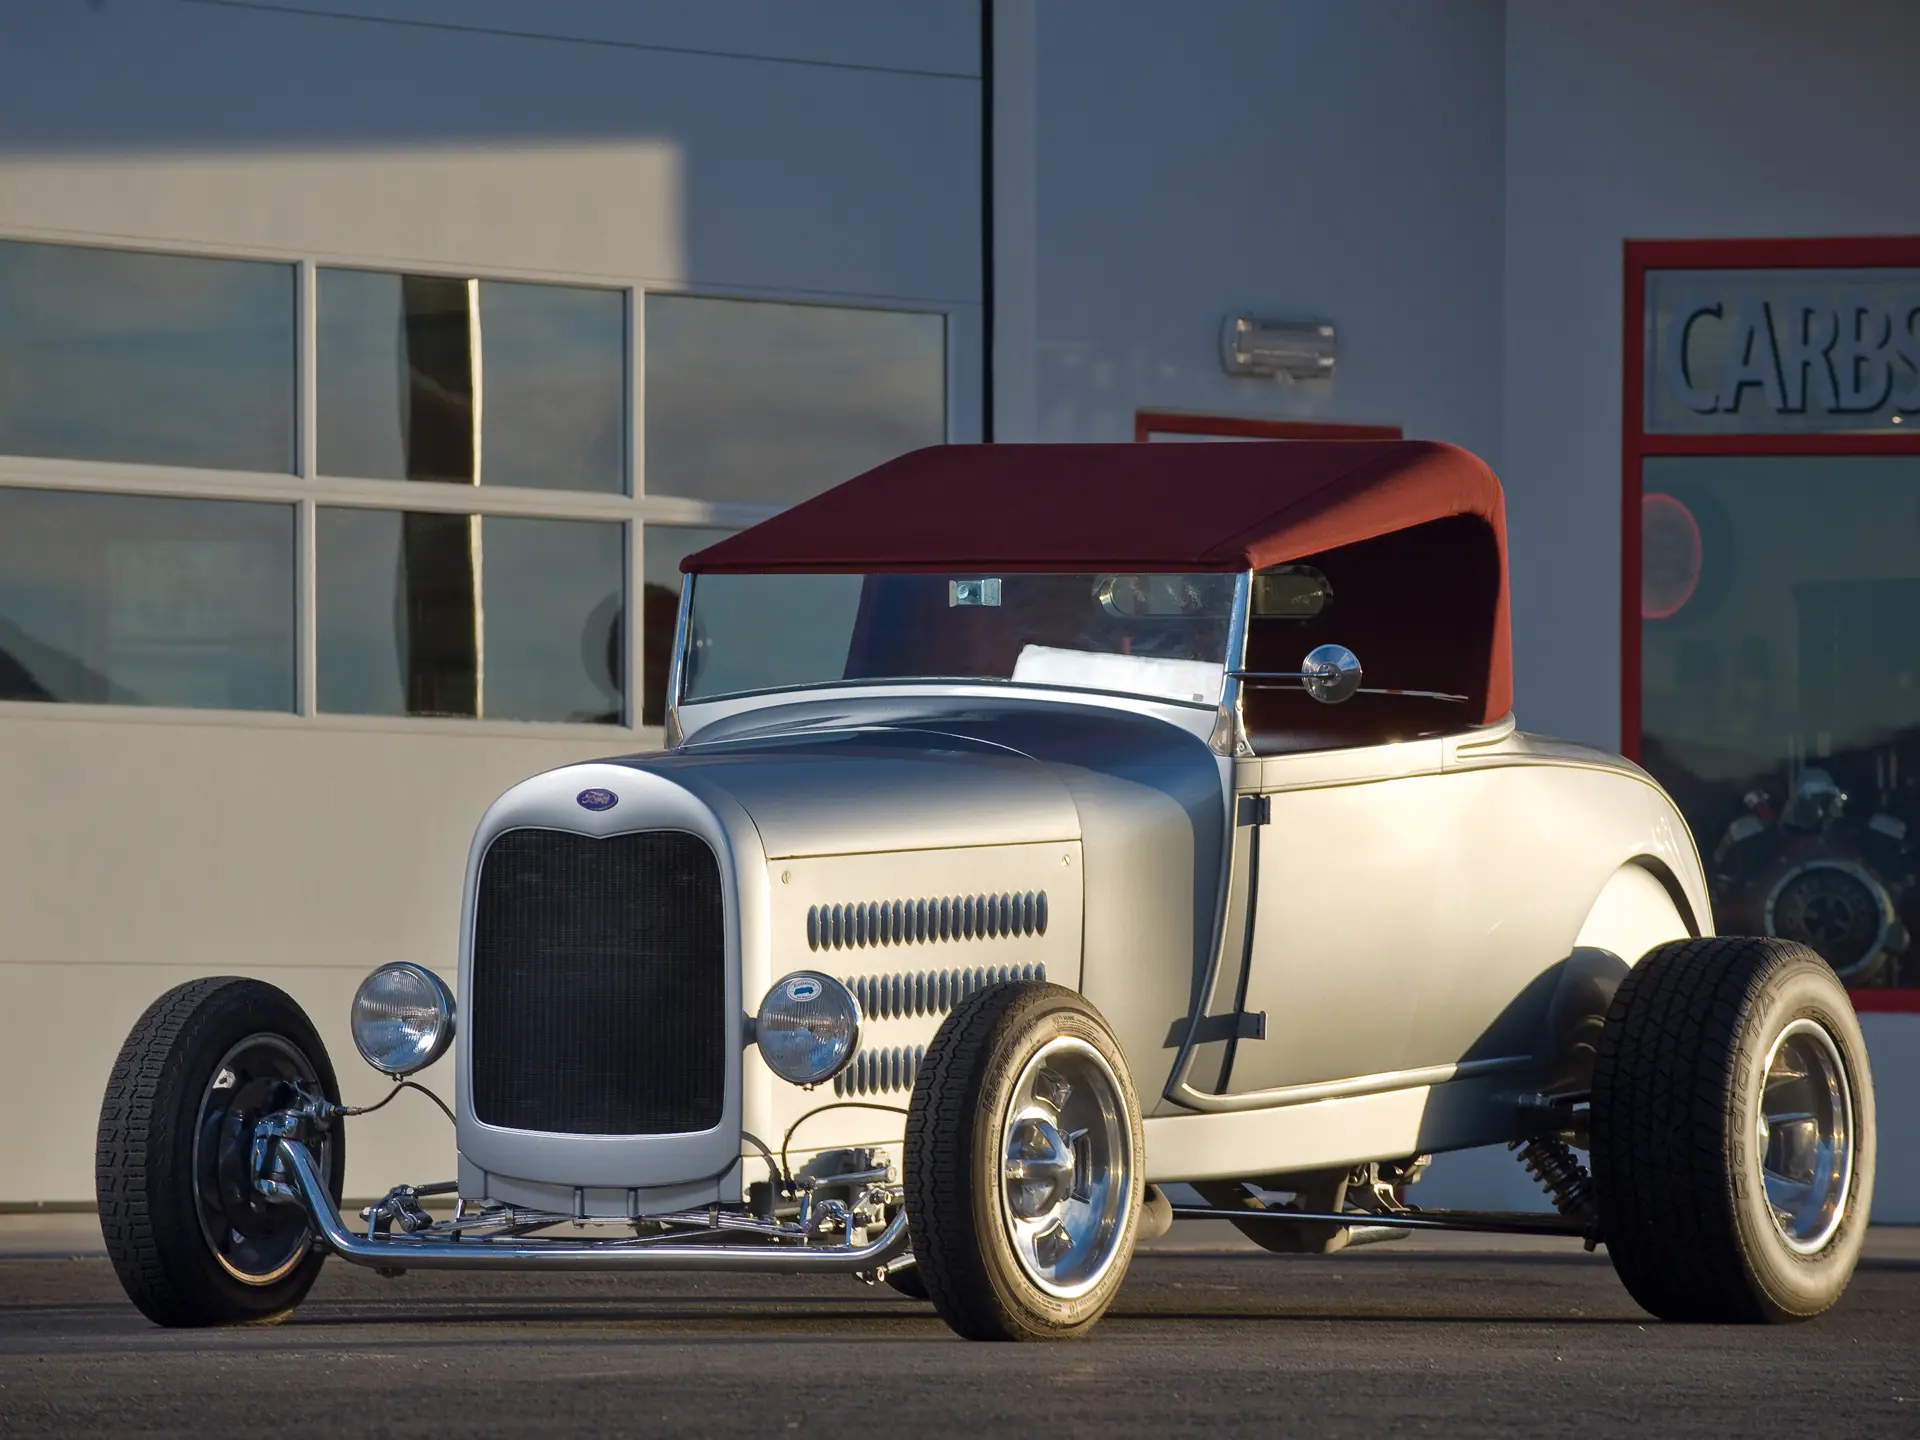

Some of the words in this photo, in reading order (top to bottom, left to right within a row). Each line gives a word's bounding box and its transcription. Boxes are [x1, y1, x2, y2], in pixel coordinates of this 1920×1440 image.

[1671, 298, 1920, 415] CARBS
[1733, 1048, 1753, 1200] Radial
[1747, 990, 1776, 1040] T/A
